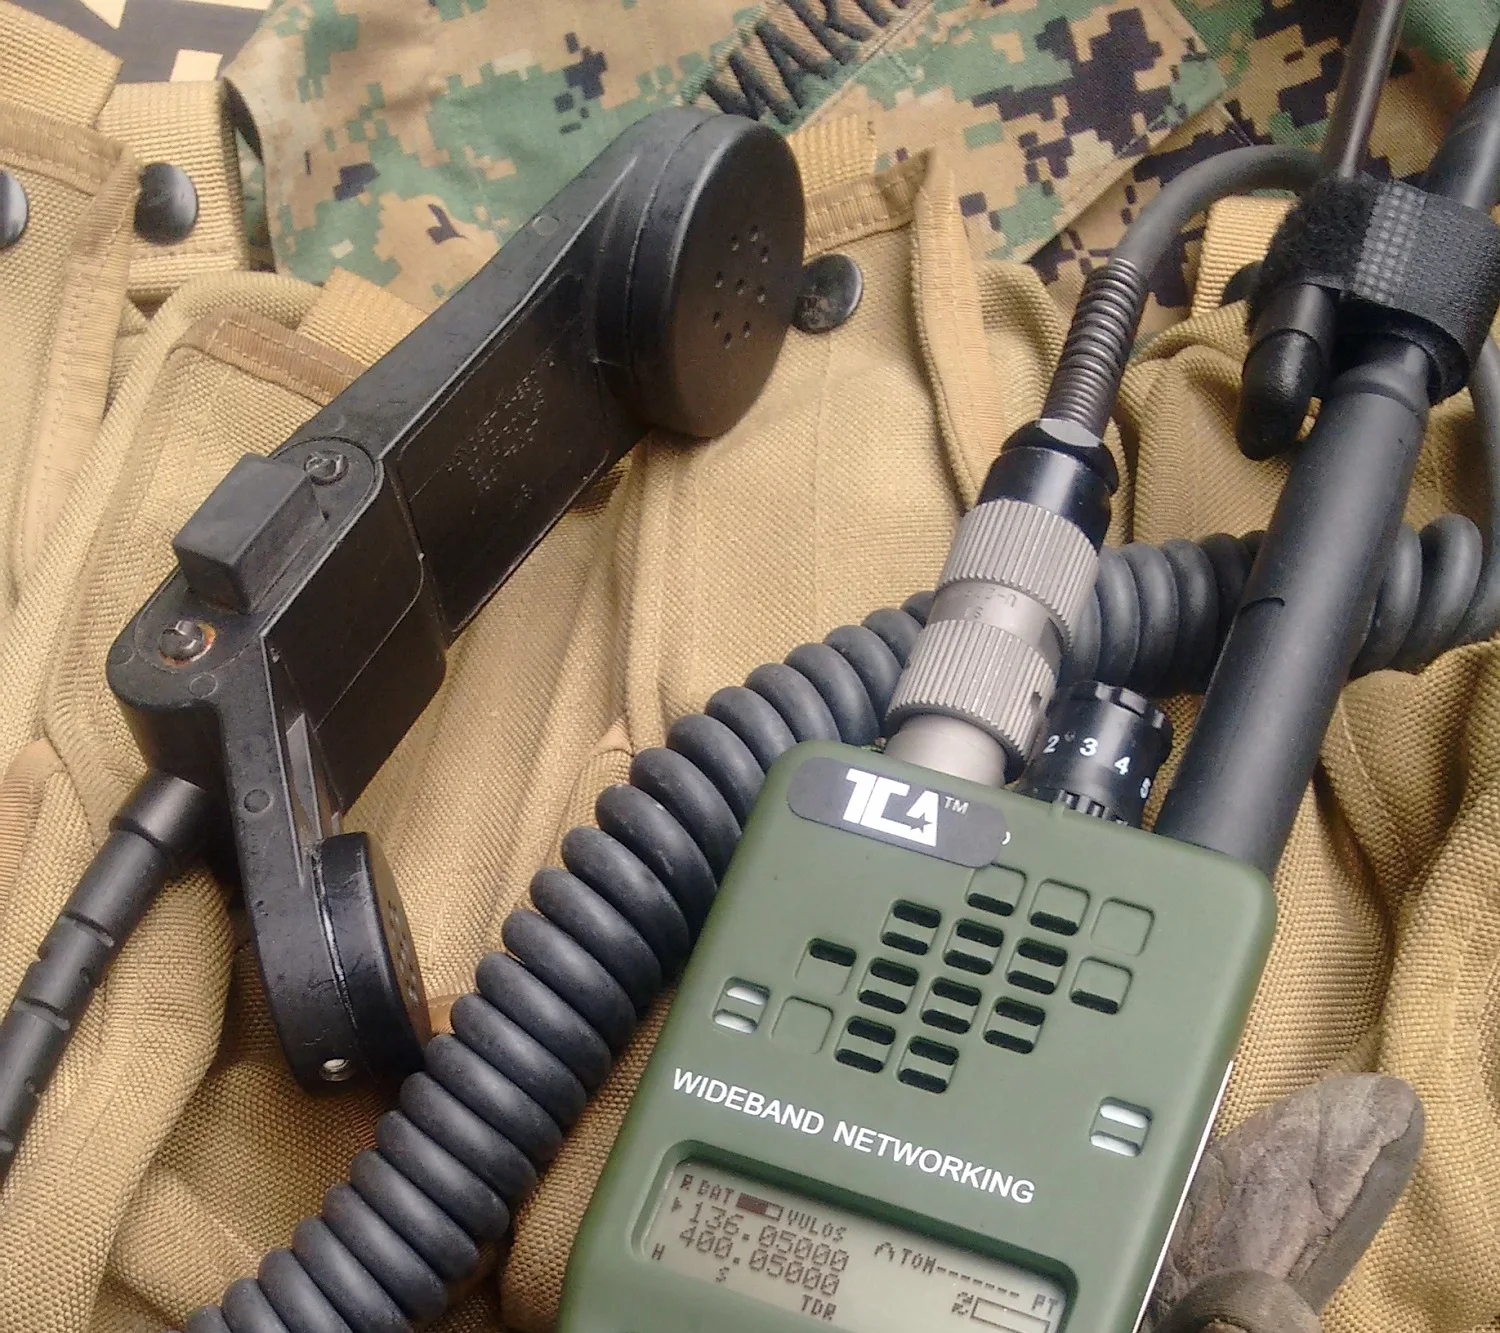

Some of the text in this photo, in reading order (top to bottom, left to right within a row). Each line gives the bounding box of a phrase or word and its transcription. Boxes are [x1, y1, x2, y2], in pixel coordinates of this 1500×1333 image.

[1043, 734, 1060, 753] 2
[1080, 737, 1099, 757] 3
[1114, 756, 1131, 776] 4
[672, 1067, 1036, 1204] WIDEBAND NETWORKING
[678, 1225, 840, 1297] 400.05000
[689, 1201, 850, 1272] 136.05000
[715, 1266, 730, 1283] S
[800, 1294, 838, 1321] TDR
